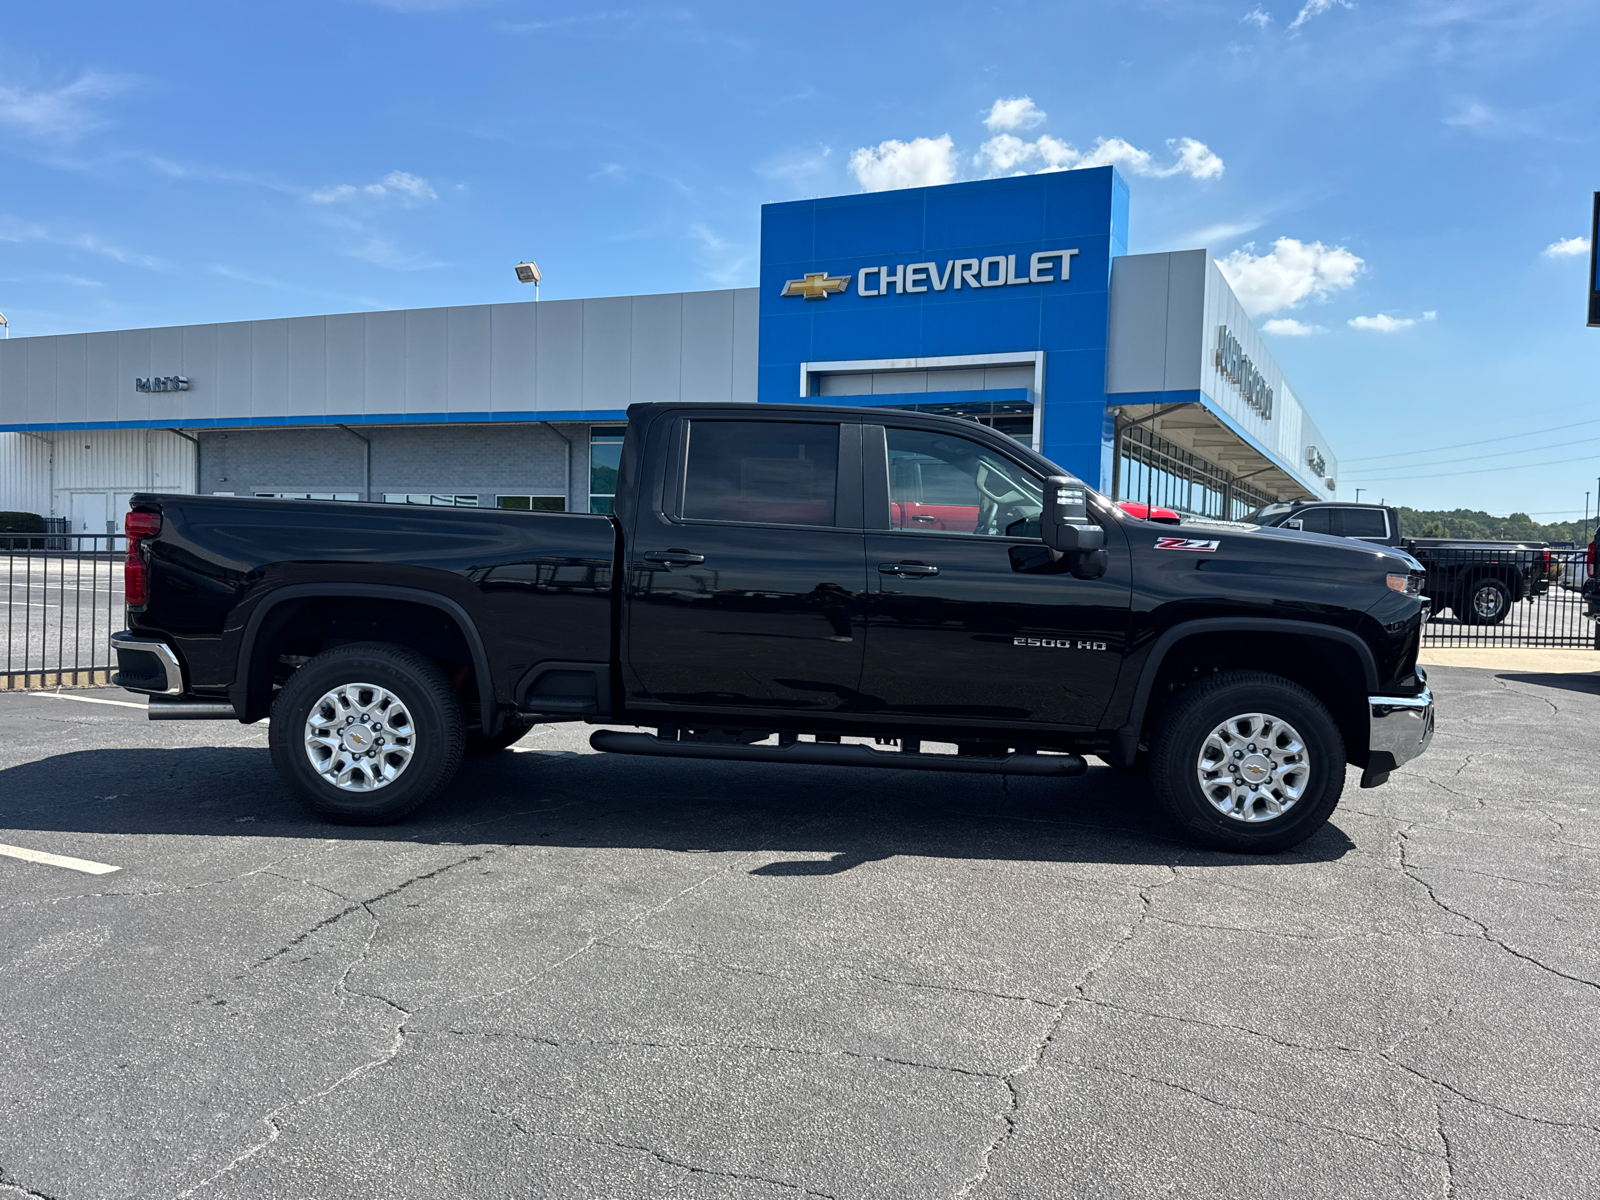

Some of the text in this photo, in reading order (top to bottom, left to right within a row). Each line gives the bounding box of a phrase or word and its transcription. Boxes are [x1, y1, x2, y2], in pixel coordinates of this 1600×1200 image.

[858, 248, 1079, 297] CHEVROLET
[135, 375, 181, 392] PARTS
[1153, 536, 1221, 553] Z71
[1013, 637, 1107, 651] 2500 HD
